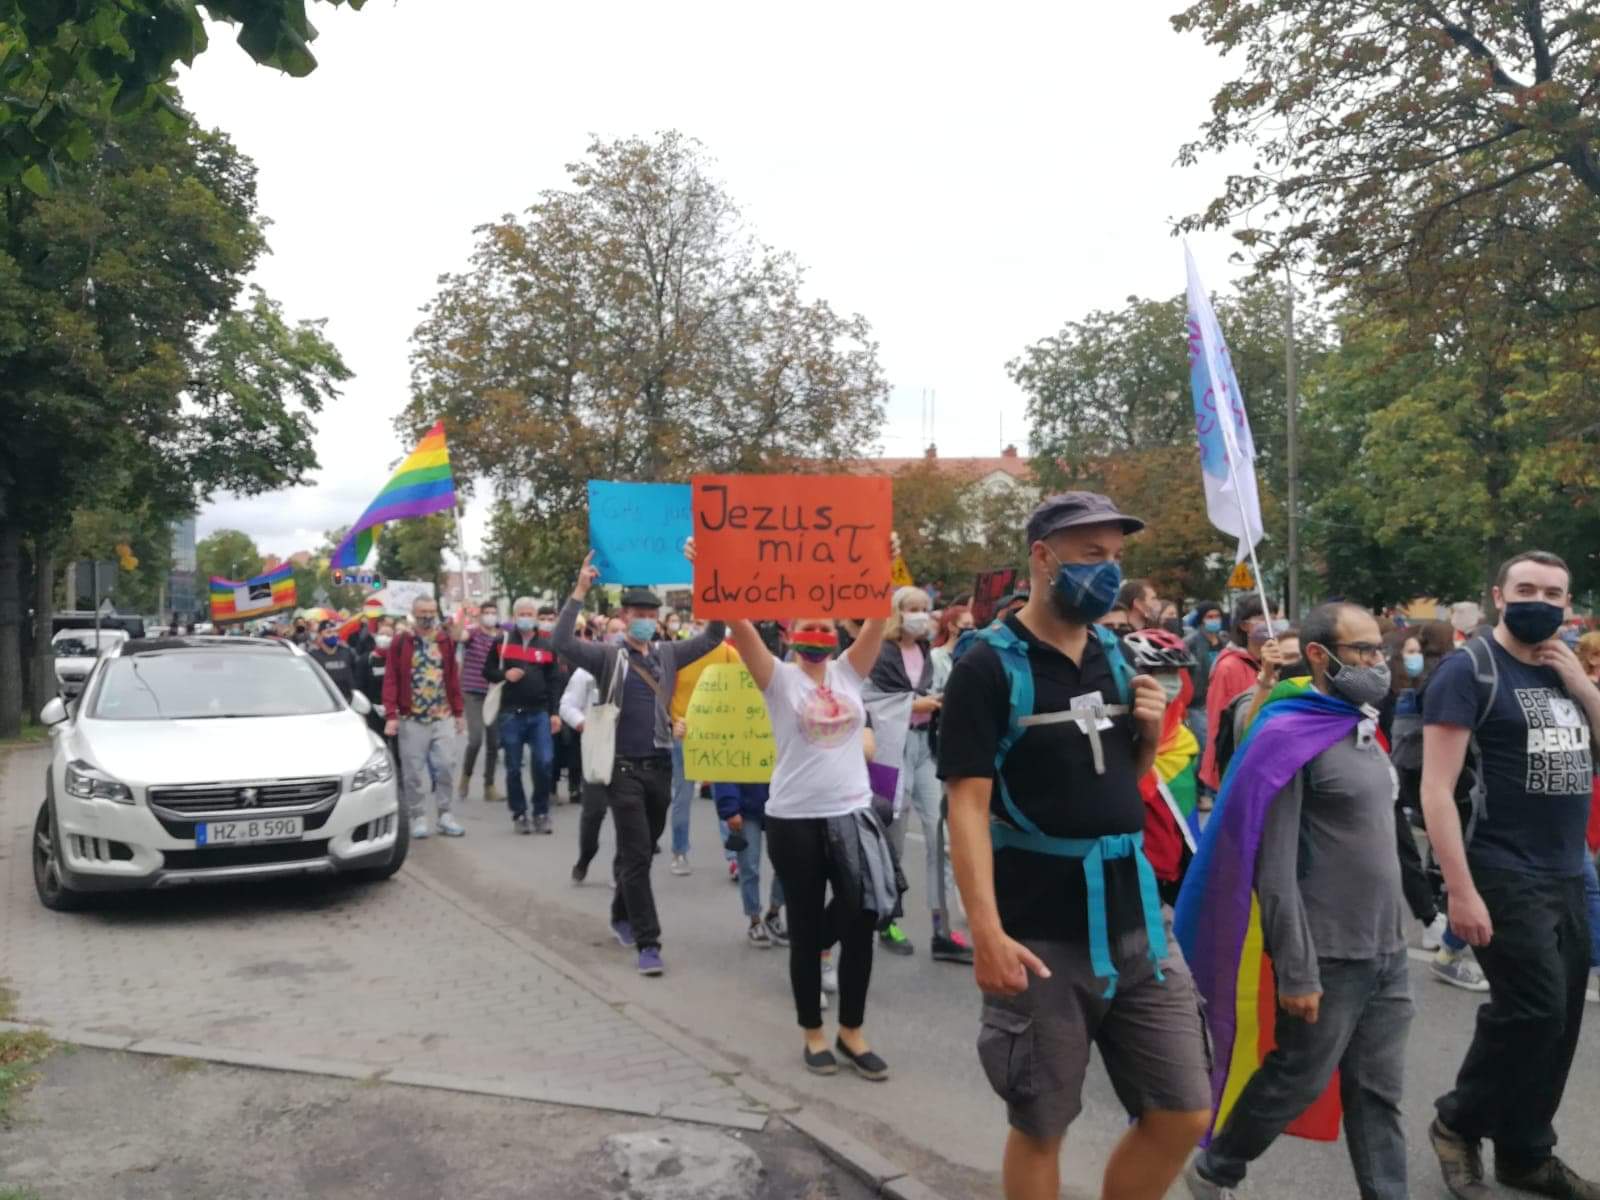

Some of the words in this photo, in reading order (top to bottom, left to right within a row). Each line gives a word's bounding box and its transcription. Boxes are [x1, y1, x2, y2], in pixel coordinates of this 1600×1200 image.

[700, 485, 833, 531] Jezus
[701, 569, 796, 603] dwóch
[808, 568, 891, 612] ojców
[687, 748, 753, 768] TAKICH
[213, 823, 237, 840] HZ
[248, 821, 259, 837] B
[264, 820, 296, 836] 590
